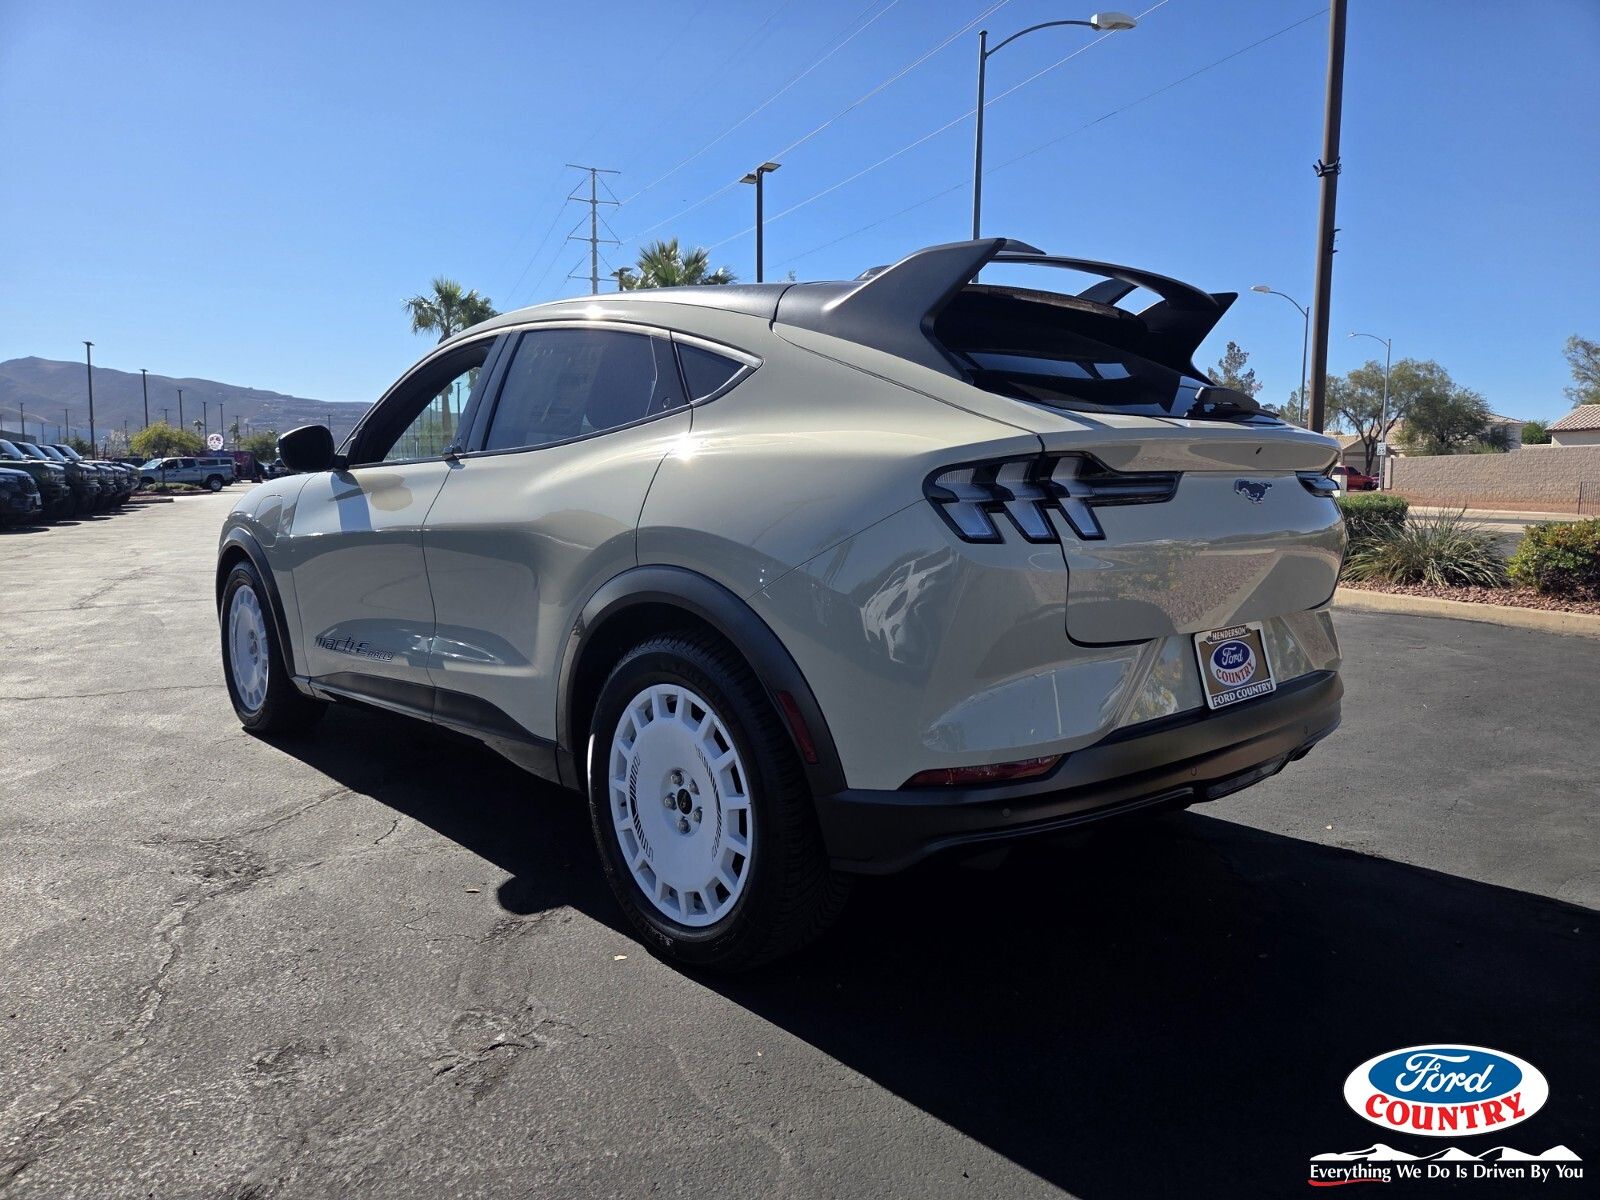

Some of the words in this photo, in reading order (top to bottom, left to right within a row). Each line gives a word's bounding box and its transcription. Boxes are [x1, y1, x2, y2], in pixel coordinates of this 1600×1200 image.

[1211, 626, 1247, 641] HENDERSON
[1221, 646, 1244, 666] Ford
[1215, 659, 1255, 684] COUNTRY
[1212, 692, 1236, 706] FORD
[1236, 682, 1272, 699] COUNTRY
